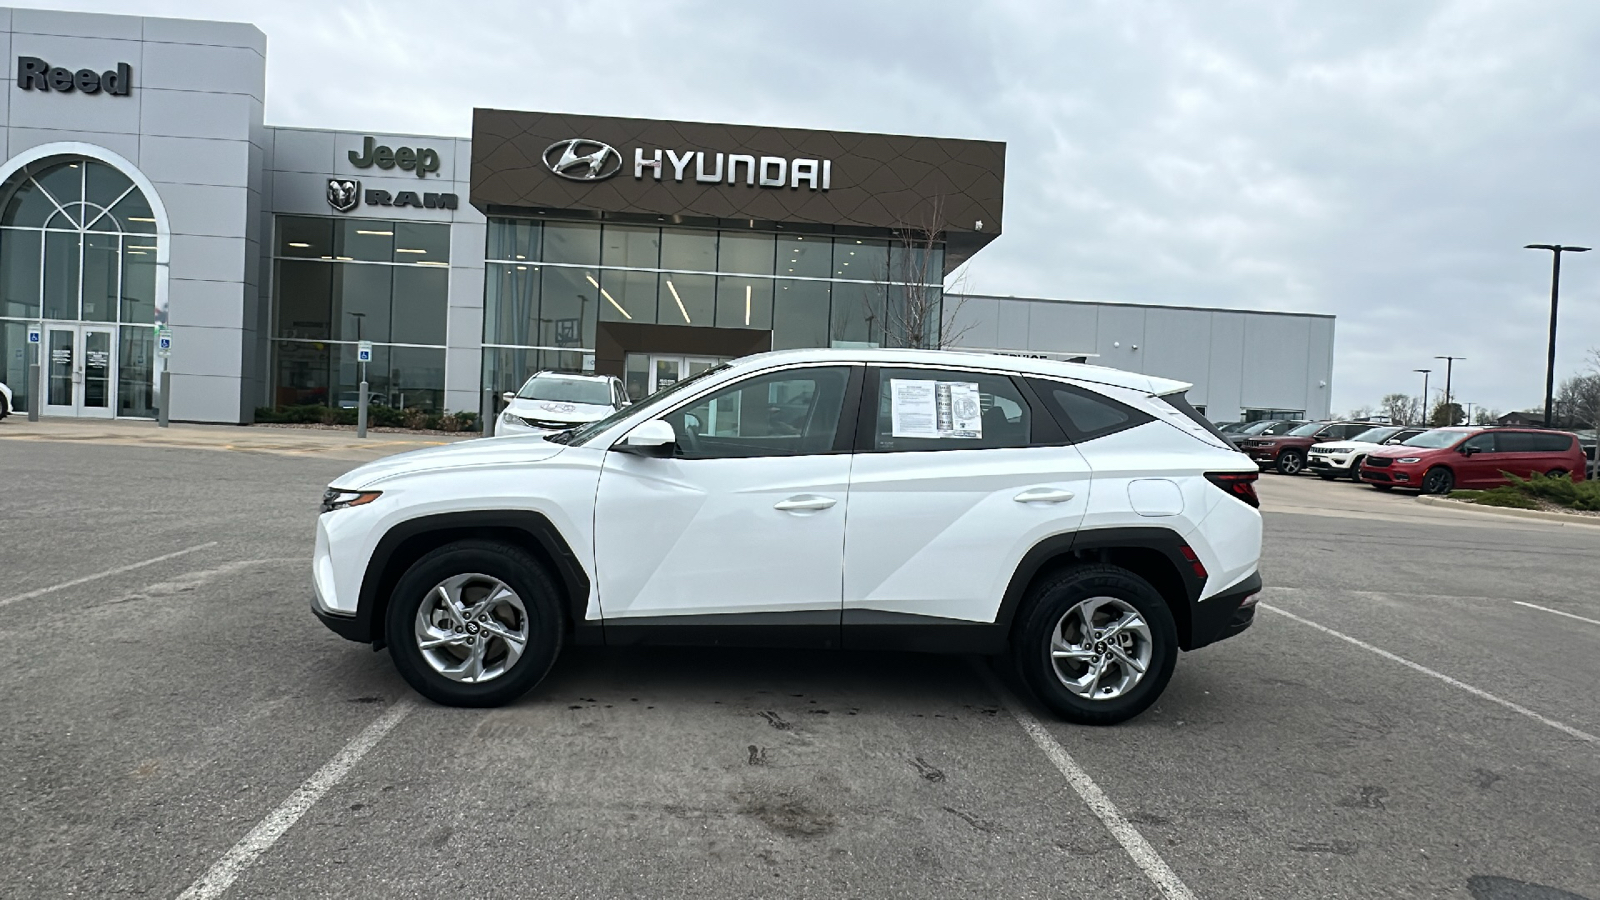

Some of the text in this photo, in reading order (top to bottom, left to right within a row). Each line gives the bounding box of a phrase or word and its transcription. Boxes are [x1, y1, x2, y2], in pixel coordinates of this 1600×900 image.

[17, 56, 131, 96] Reed
[348, 136, 440, 177] Jeep
[634, 147, 831, 191] HYUNDAI
[365, 189, 459, 210] RAM
